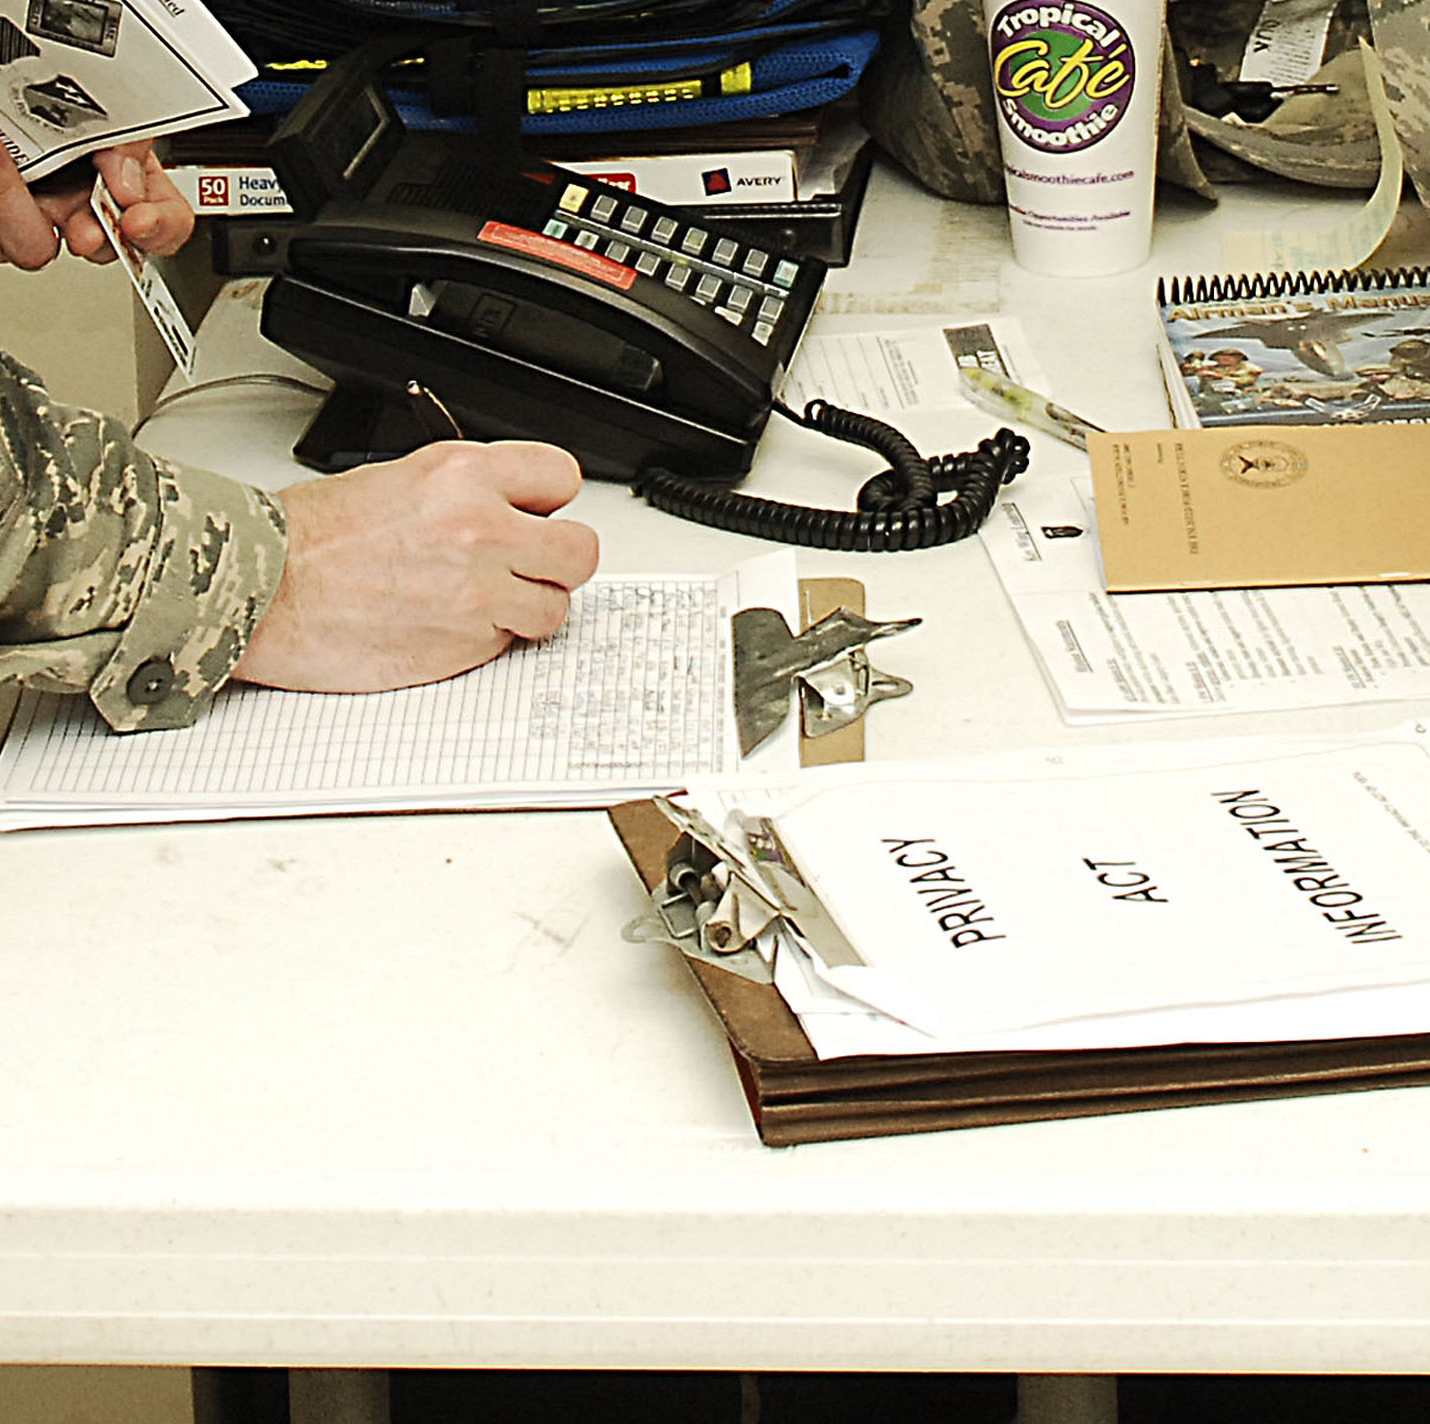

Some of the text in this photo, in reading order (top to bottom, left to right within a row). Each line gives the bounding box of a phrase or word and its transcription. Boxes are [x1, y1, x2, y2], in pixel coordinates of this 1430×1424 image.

[997, 3, 1121, 48] Tropical
[994, 39, 1131, 109] Café
[1002, 98, 1119, 146] smoothie
[201, 178, 226, 196] 50
[240, 193, 285, 206] Docum
[736, 176, 782, 187] AVERY
[1169, 299, 1315, 322] Airman's
[1082, 857, 1169, 904] ACT
[1210, 787, 1403, 946] INFORMATION
[880, 836, 1007, 950] PRIVACY
